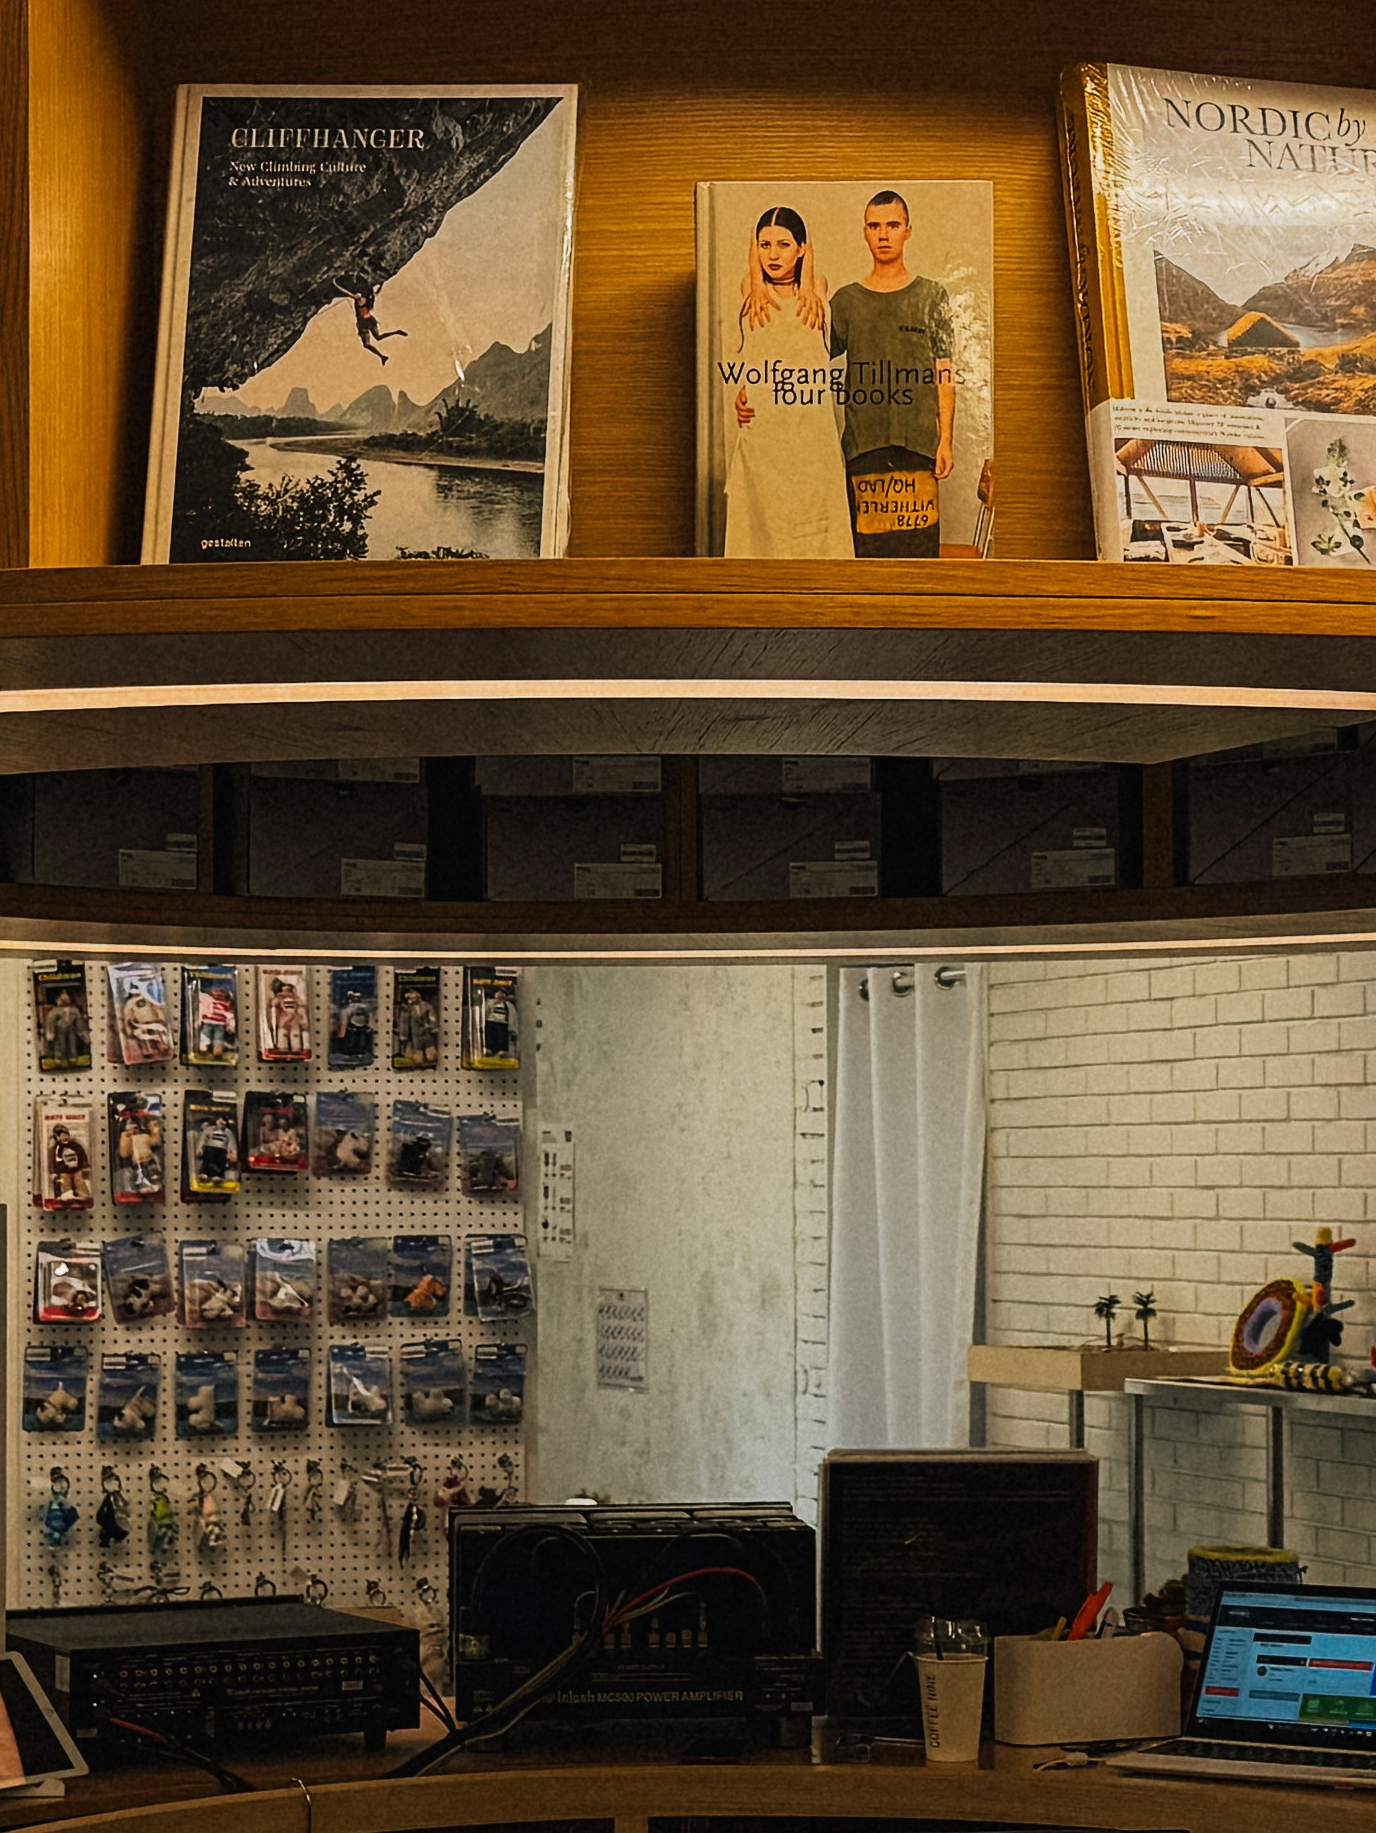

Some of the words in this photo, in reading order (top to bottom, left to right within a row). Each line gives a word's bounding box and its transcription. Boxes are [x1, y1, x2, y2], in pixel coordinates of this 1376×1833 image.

[1163, 98, 1331, 141] NORDIC
[1336, 108, 1366, 146] by
[230, 126, 426, 149] CLIFFHANGER
[230, 161, 258, 173] New
[260, 161, 316, 175] Climbing
[319, 161, 367, 174] Culture
[241, 175, 312, 188] Adventures
[717, 360, 846, 394] Wolfgang
[852, 360, 967, 387] Tillmans
[772, 379, 827, 406] four
[836, 379, 914, 406] books
[200, 537, 251, 550] gestalten
